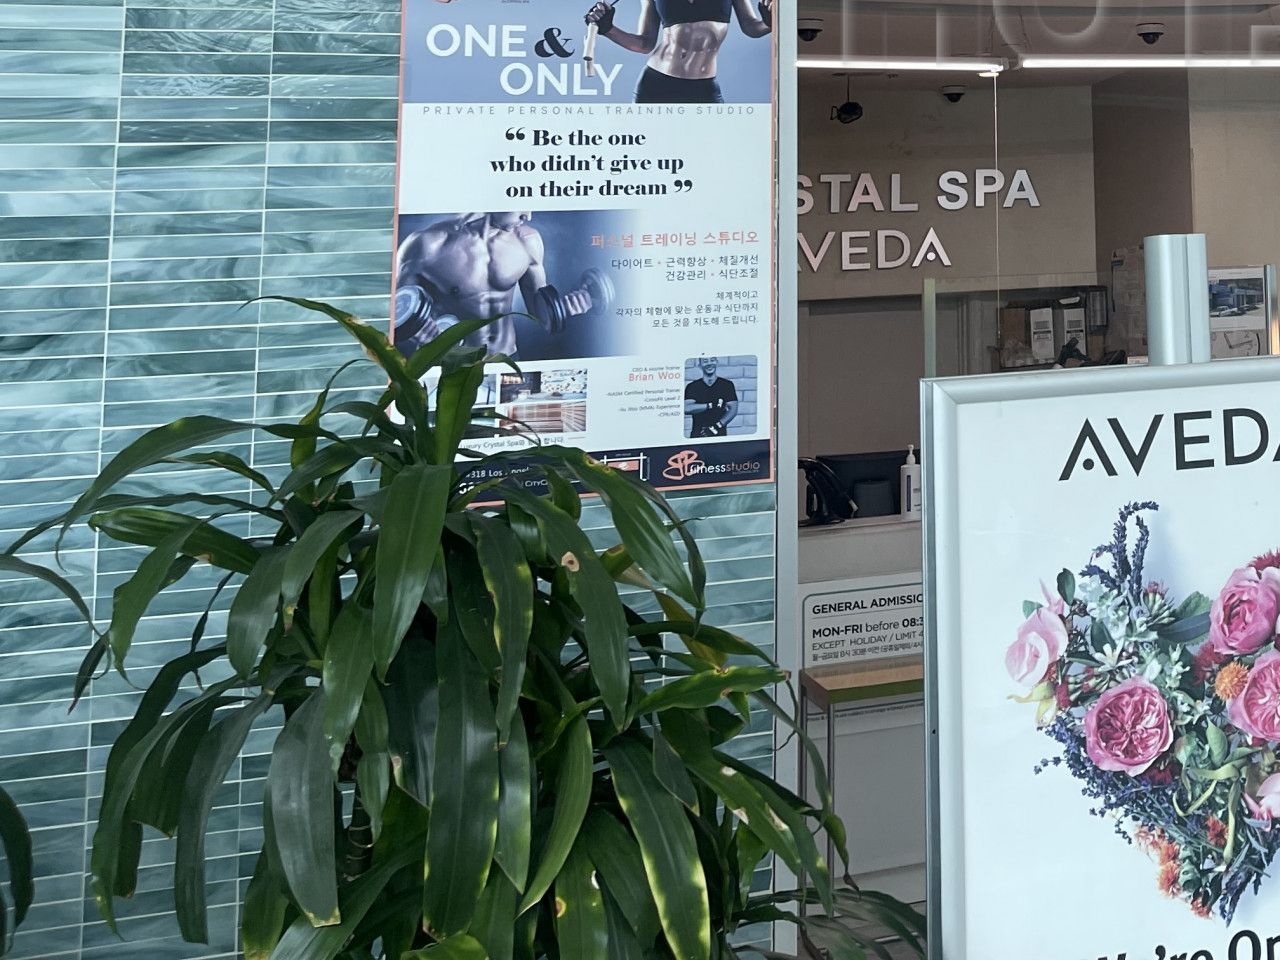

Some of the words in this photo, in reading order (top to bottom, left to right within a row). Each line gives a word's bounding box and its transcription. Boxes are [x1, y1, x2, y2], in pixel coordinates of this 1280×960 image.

[426, 23, 527, 57] ONE
[534, 27, 576, 58] &
[499, 62, 623, 96] ONLY
[423, 106, 496, 115] PRIVATE
[508, 106, 595, 115] PERSONAL
[605, 105, 686, 115] TRAINING
[696, 105, 755, 115] STUDIO
[532, 129, 562, 146] Be
[567, 129, 602, 146] the
[607, 133, 646, 146] one
[490, 155, 536, 173] who
[609, 158, 652, 175] give
[657, 157, 684, 174] up
[505, 185, 533, 198] on
[539, 180, 594, 197] their
[599, 180, 667, 196] dream
[936, 169, 1040, 210] SPA
[640, 232, 697, 247] 트레이닝
[703, 230, 759, 245] 스튜디오
[797, 226, 952, 271] VEDA
[611, 258, 654, 269] 다이어트
[666, 270, 706, 281] 건강관리
[629, 373, 654, 381] Brian
[658, 372, 680, 380] Woo
[813, 600, 867, 614] GENERAL
[813, 624, 862, 638] MON-FRI
[866, 621, 899, 632] before
[813, 640, 845, 650] EXCEPT
[850, 635, 887, 646] HOLIDAY
[896, 631, 916, 640] LIMIT
